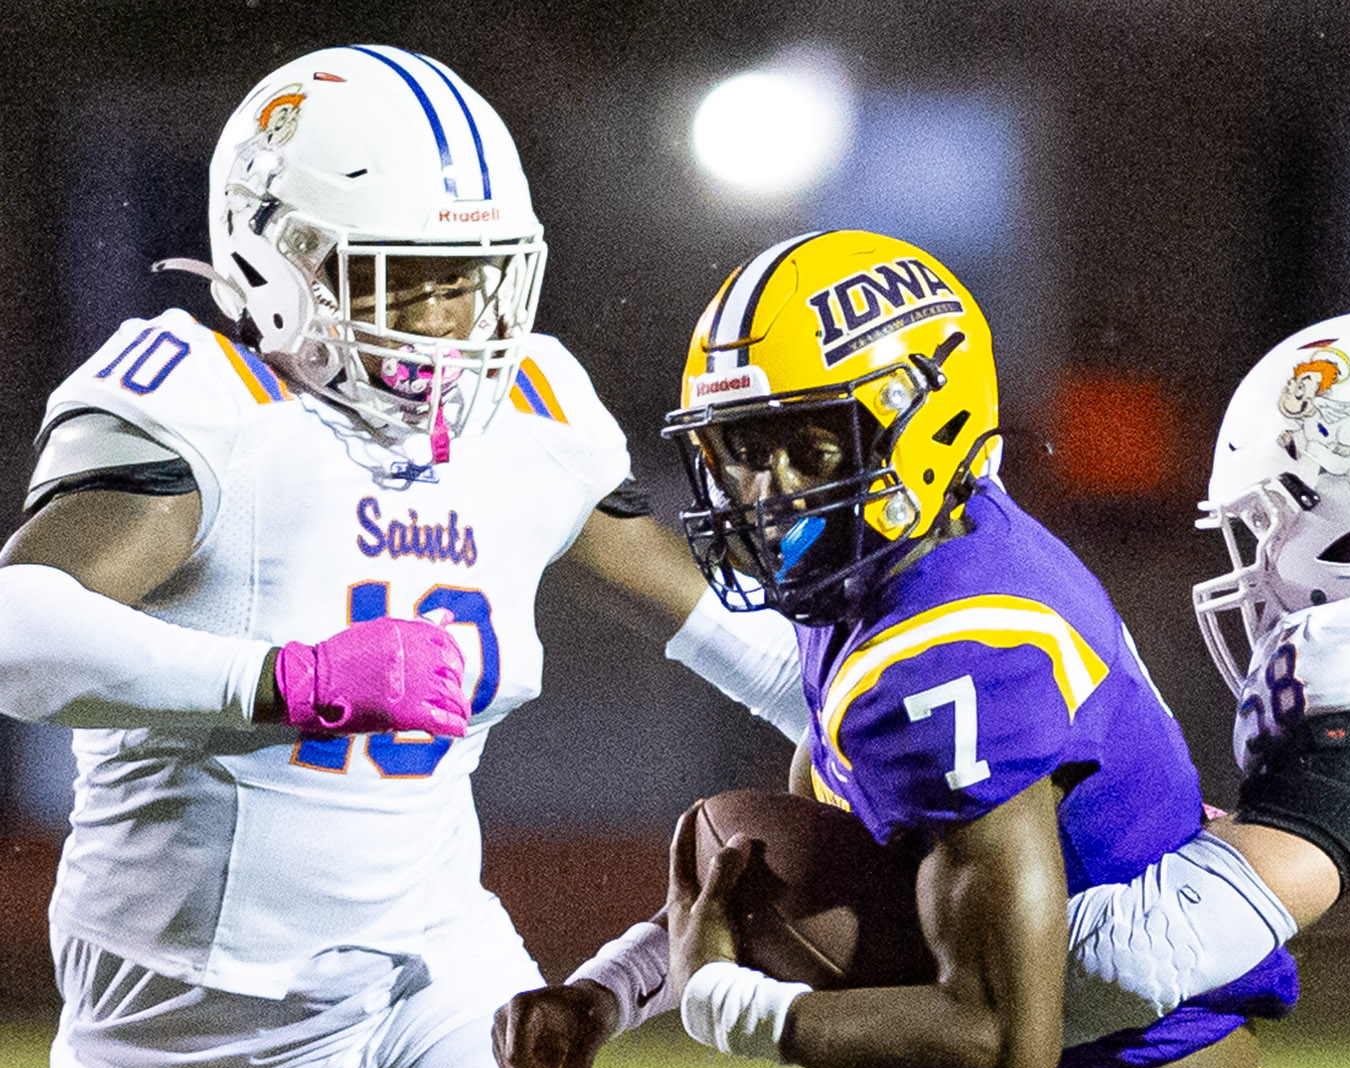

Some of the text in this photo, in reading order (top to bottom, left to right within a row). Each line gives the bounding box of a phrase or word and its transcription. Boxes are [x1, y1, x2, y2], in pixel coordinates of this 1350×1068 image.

[809, 259, 955, 346] IOWA
[93, 326, 192, 397] 10
[356, 494, 478, 568] Saints
[903, 674, 991, 791] 7
